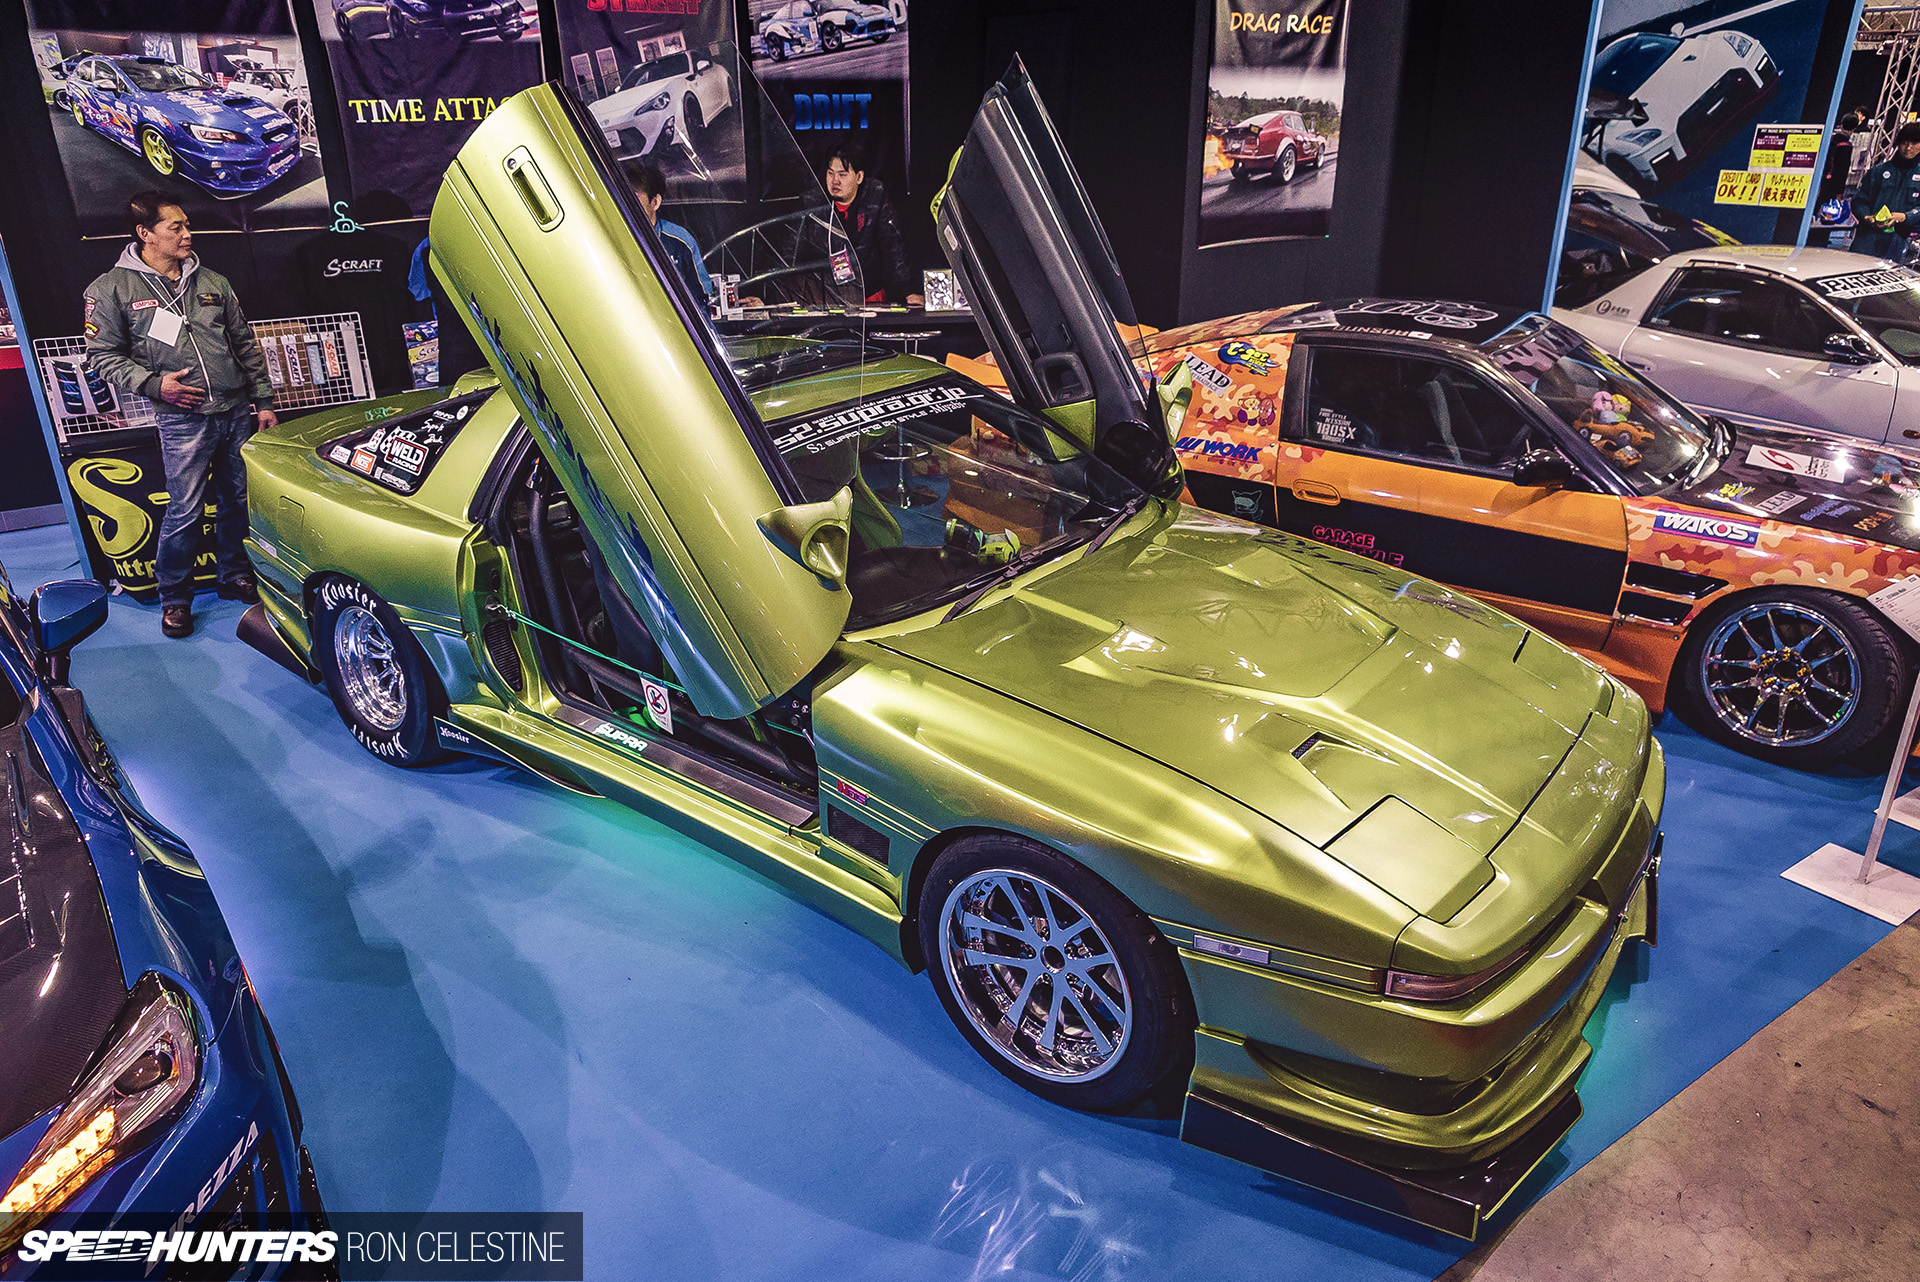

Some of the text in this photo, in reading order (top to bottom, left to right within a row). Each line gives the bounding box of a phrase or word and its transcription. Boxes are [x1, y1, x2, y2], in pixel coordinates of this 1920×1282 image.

[1229, 12, 1334, 34] DRAG RACE
[348, 96, 512, 124] TIME ATTA
[793, 93, 872, 131] DRIFT
[1721, 172, 1761, 184] CREDIT CARD
[1184, 355, 1231, 388] LEAD
[1315, 421, 1357, 440] 180SX
[354, 453, 373, 469] NOS
[389, 441, 425, 466] WELD
[1202, 439, 1263, 461] WORK
[391, 456, 419, 472] RACING
[1311, 525, 1375, 549] GARAGE
[322, 582, 377, 613] Hoosier
[440, 726, 470, 744] Hoosier
[592, 722, 648, 752] SUPRA
